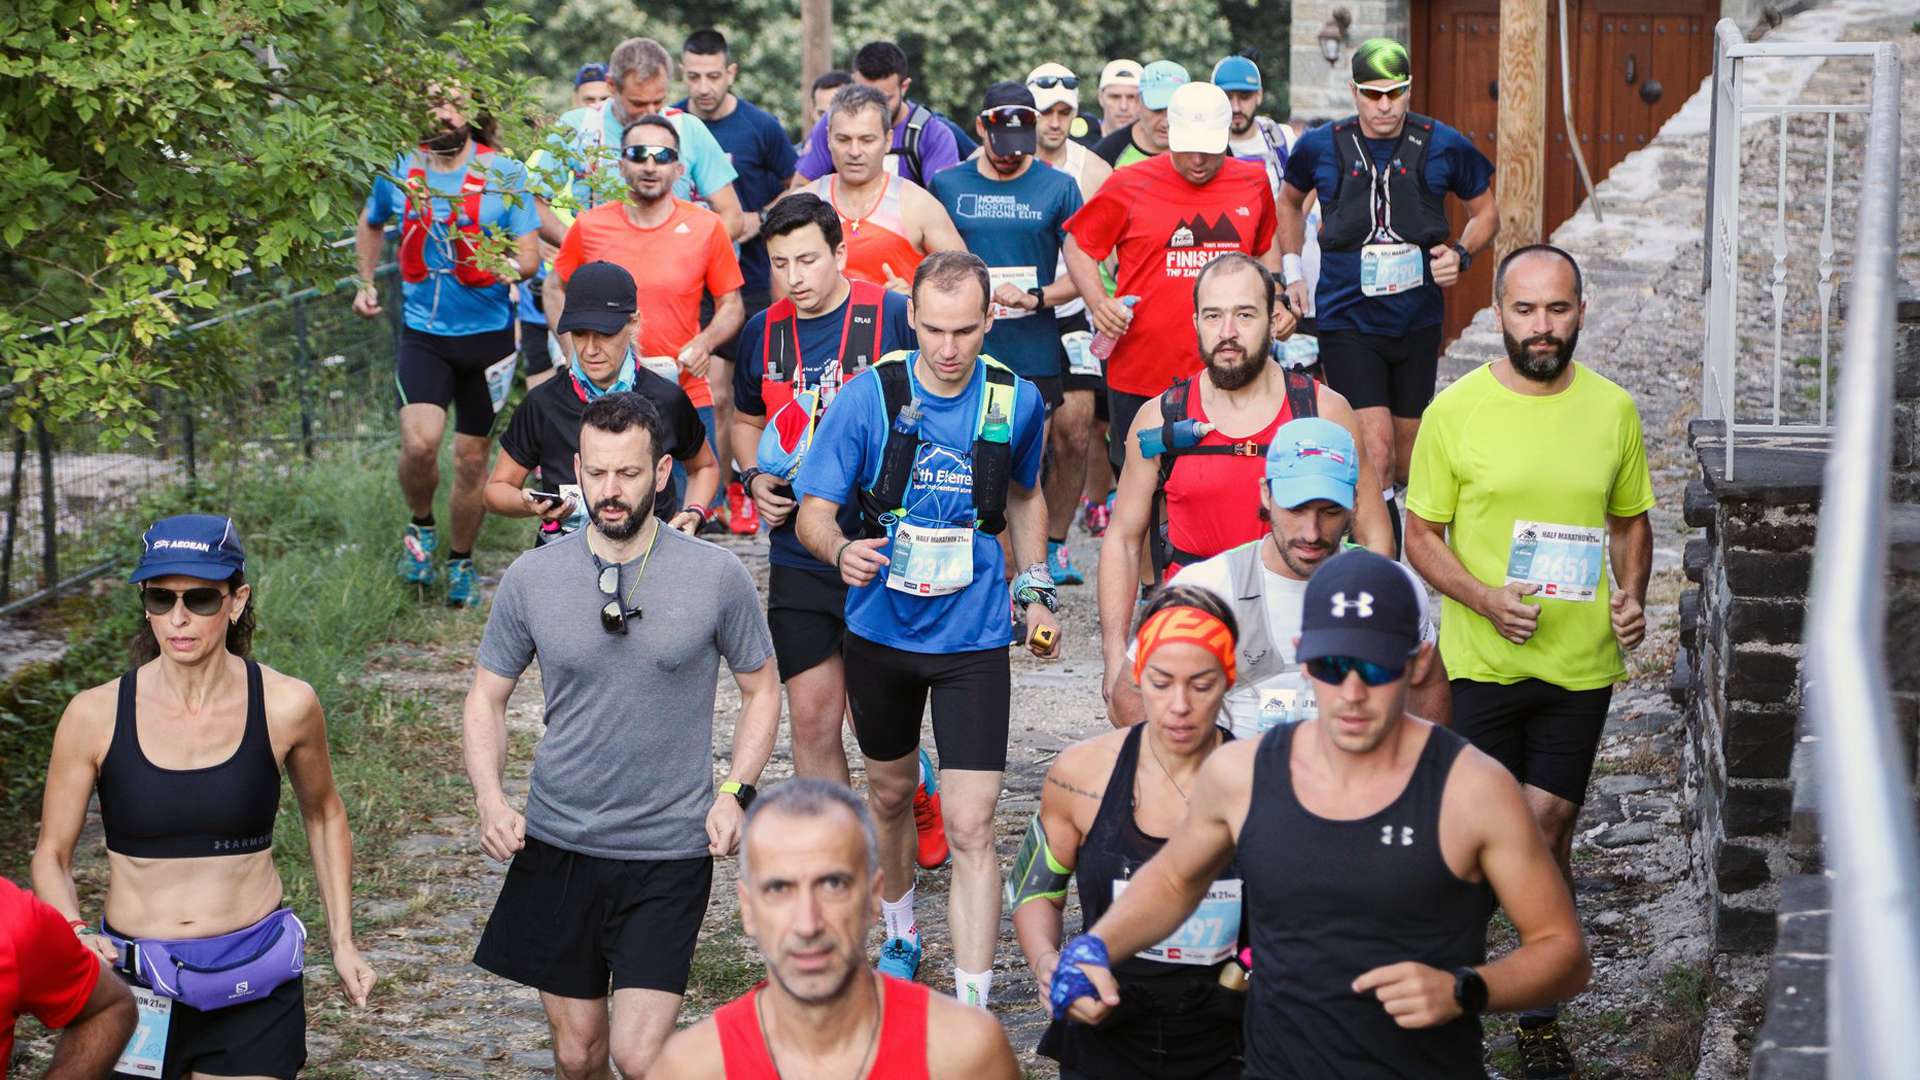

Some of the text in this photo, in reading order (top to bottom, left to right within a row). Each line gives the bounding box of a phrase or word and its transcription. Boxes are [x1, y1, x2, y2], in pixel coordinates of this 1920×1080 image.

[978, 203, 1030, 212] NORTHERN
[977, 210, 1043, 220] ARIZONA ELITE
[1166, 251, 1236, 268] FINISH
[936, 470, 974, 486] Eleme
[930, 535, 957, 543] MARATHON
[1542, 530, 1558, 539] HALF
[170, 540, 210, 552] AEGEAN
[1534, 554, 1588, 584] 2651
